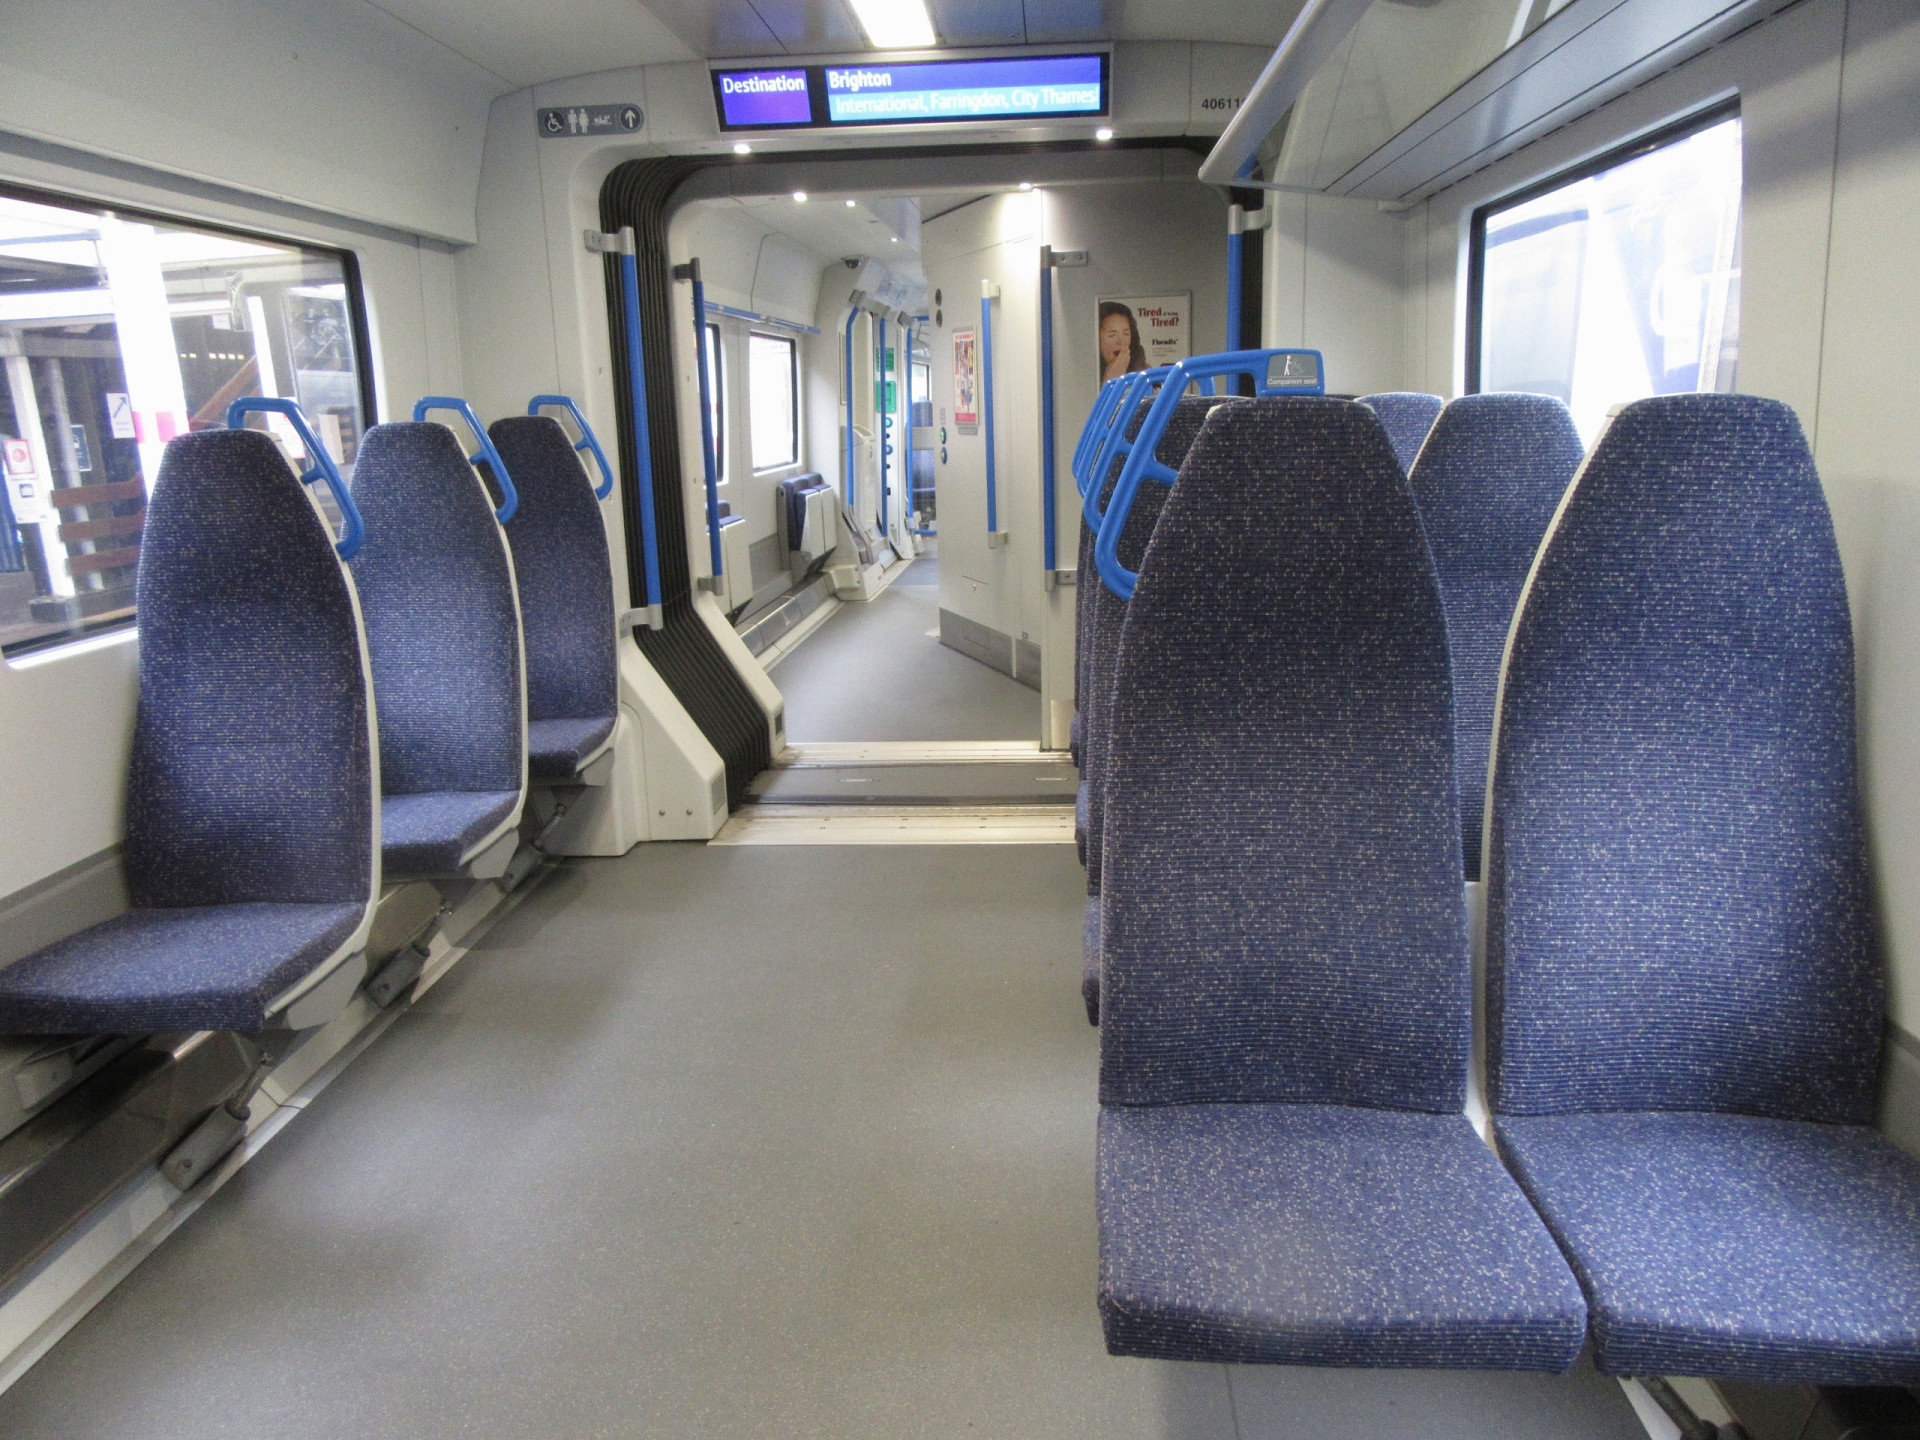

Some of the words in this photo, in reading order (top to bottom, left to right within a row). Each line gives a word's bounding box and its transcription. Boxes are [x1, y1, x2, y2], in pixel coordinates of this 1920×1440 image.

[722, 75, 805, 93] Destination
[829, 71, 892, 92] Brighton
[835, 94, 928, 114] International,
[930, 90, 1009, 112] Farringdon,
[1011, 89, 1040, 109] City
[1202, 98, 1246, 109] 40611
[1137, 307, 1162, 317] Tired
[1151, 316, 1179, 327] Tired?
[1267, 378, 1302, 386] Companion
